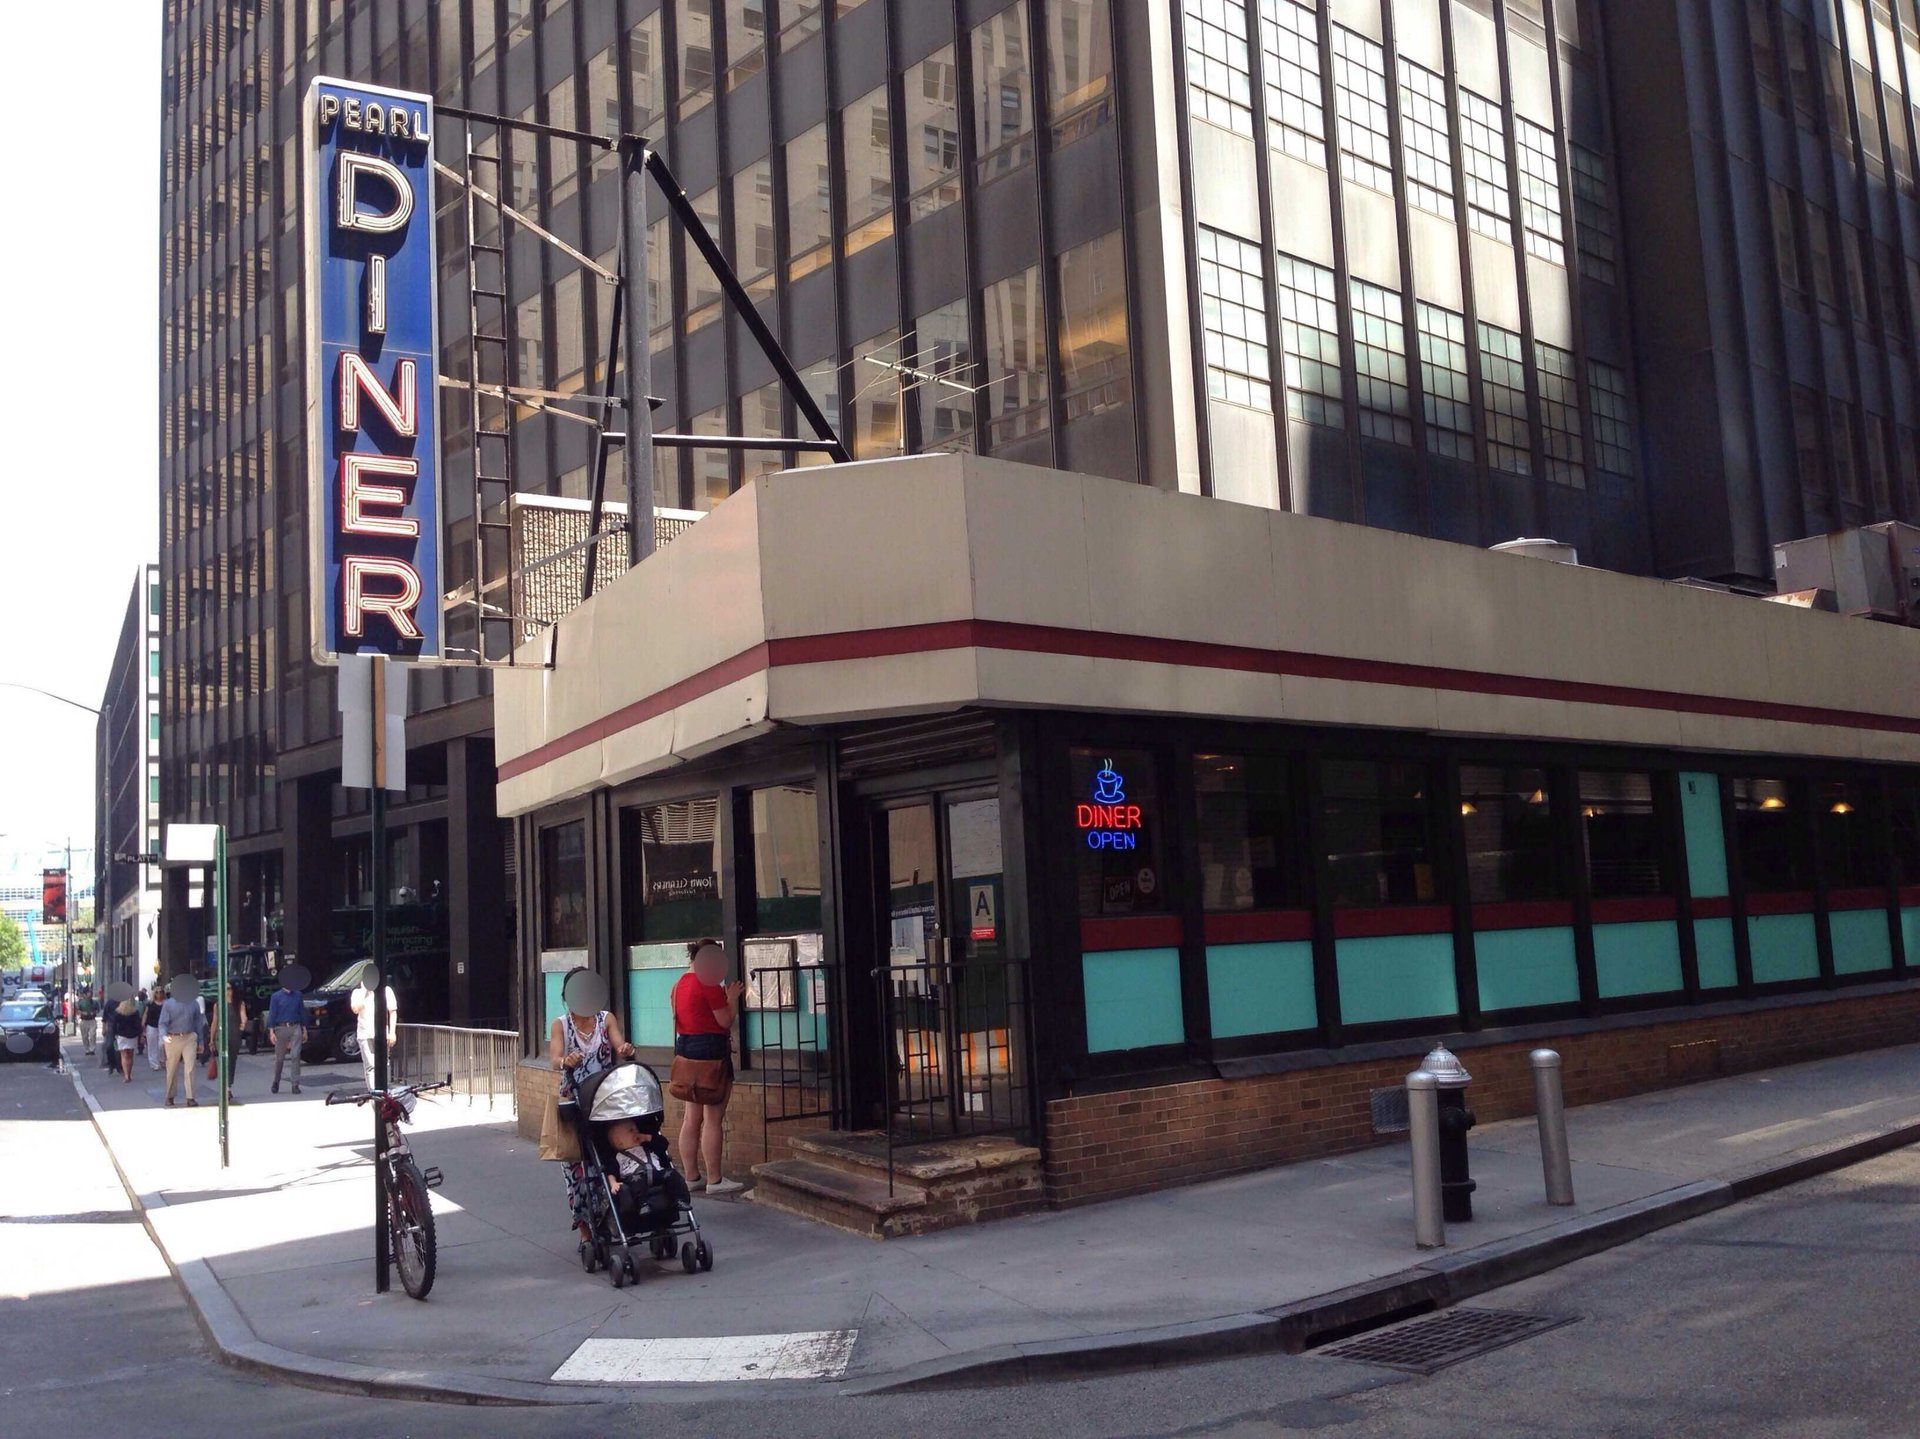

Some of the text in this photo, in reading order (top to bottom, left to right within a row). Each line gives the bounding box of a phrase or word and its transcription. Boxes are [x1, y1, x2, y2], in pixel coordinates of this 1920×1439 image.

[320, 92, 430, 141] PEARL
[336, 148, 425, 639] DINER
[1077, 805, 1142, 828] DINER
[1088, 831, 1135, 849] OPEN
[127, 855, 150, 863] PLATT
[1109, 880, 1131, 900] OPEN
[975, 890, 991, 916] A
